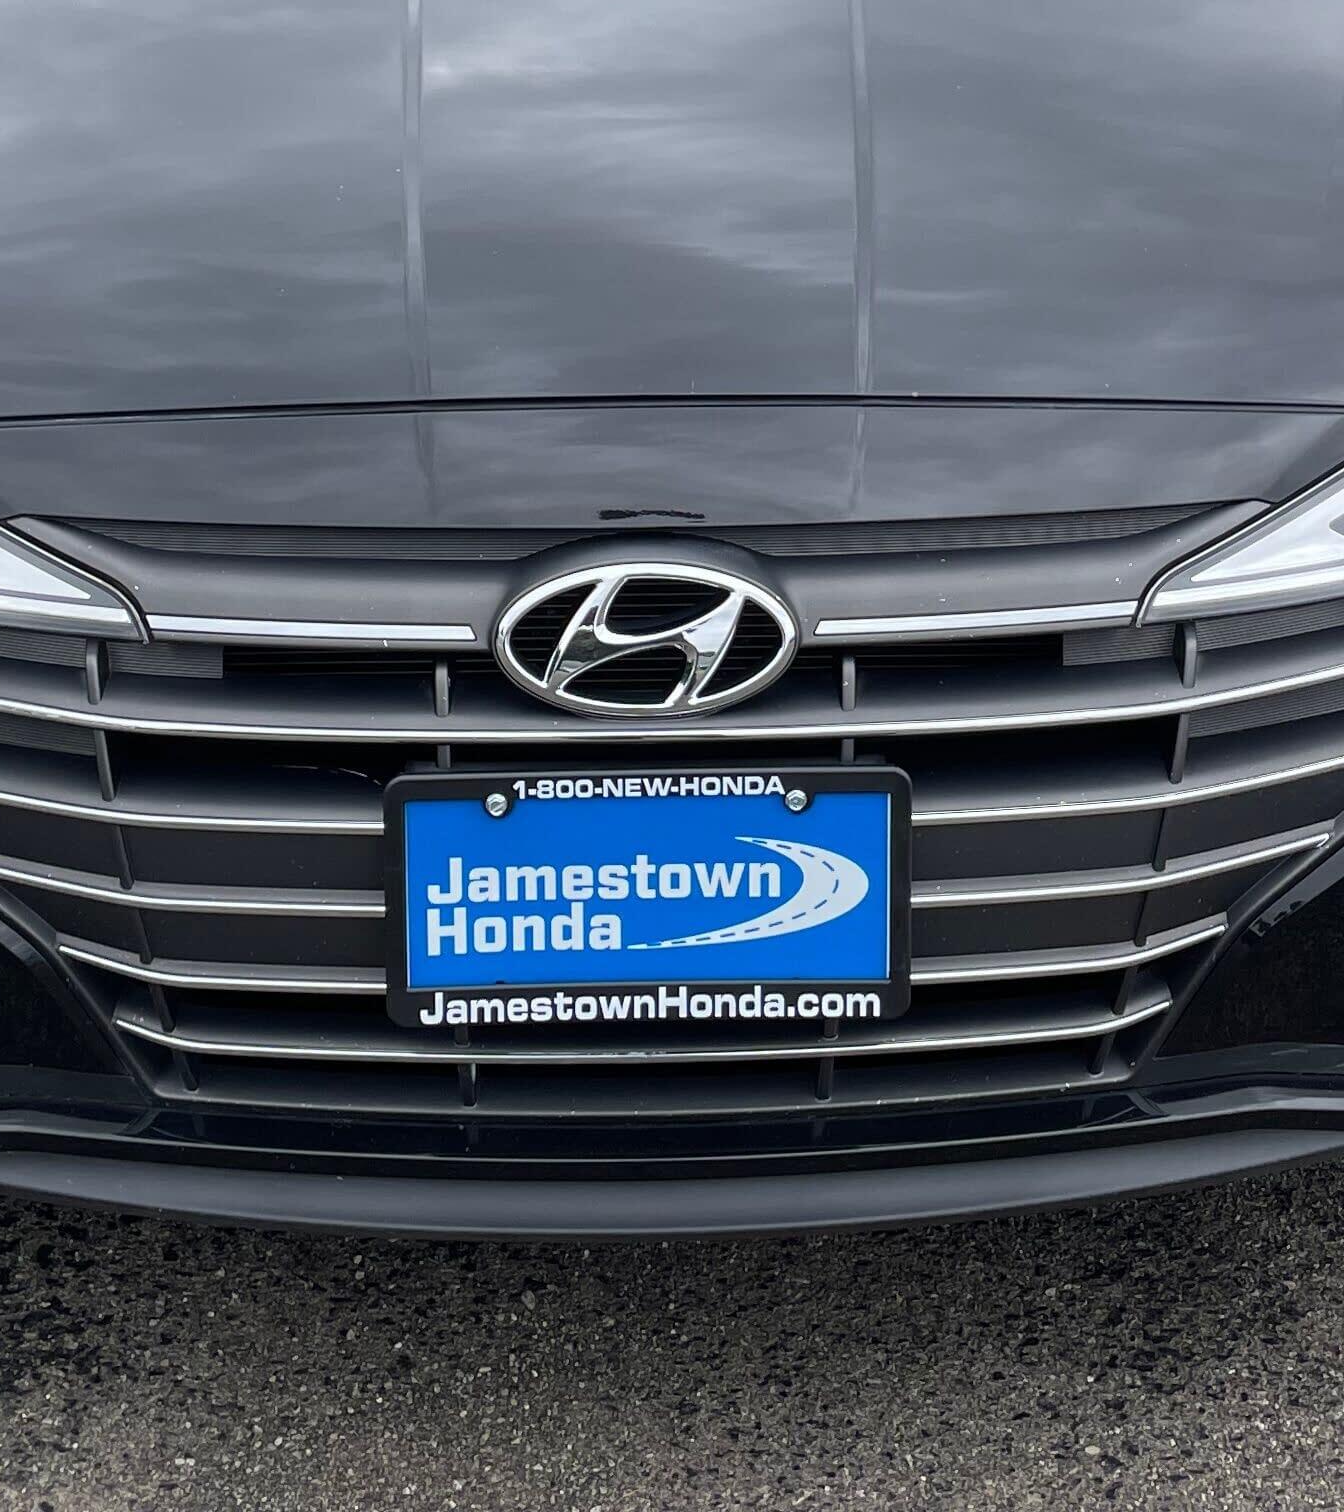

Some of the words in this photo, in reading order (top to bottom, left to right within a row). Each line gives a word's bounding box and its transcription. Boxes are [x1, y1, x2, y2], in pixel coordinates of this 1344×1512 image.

[513, 775, 786, 800] 1-800-NEW-HONDA
[427, 854, 782, 905] Jamestown
[426, 902, 622, 957] Honda
[419, 985, 882, 1026] JamestownHonda.com
